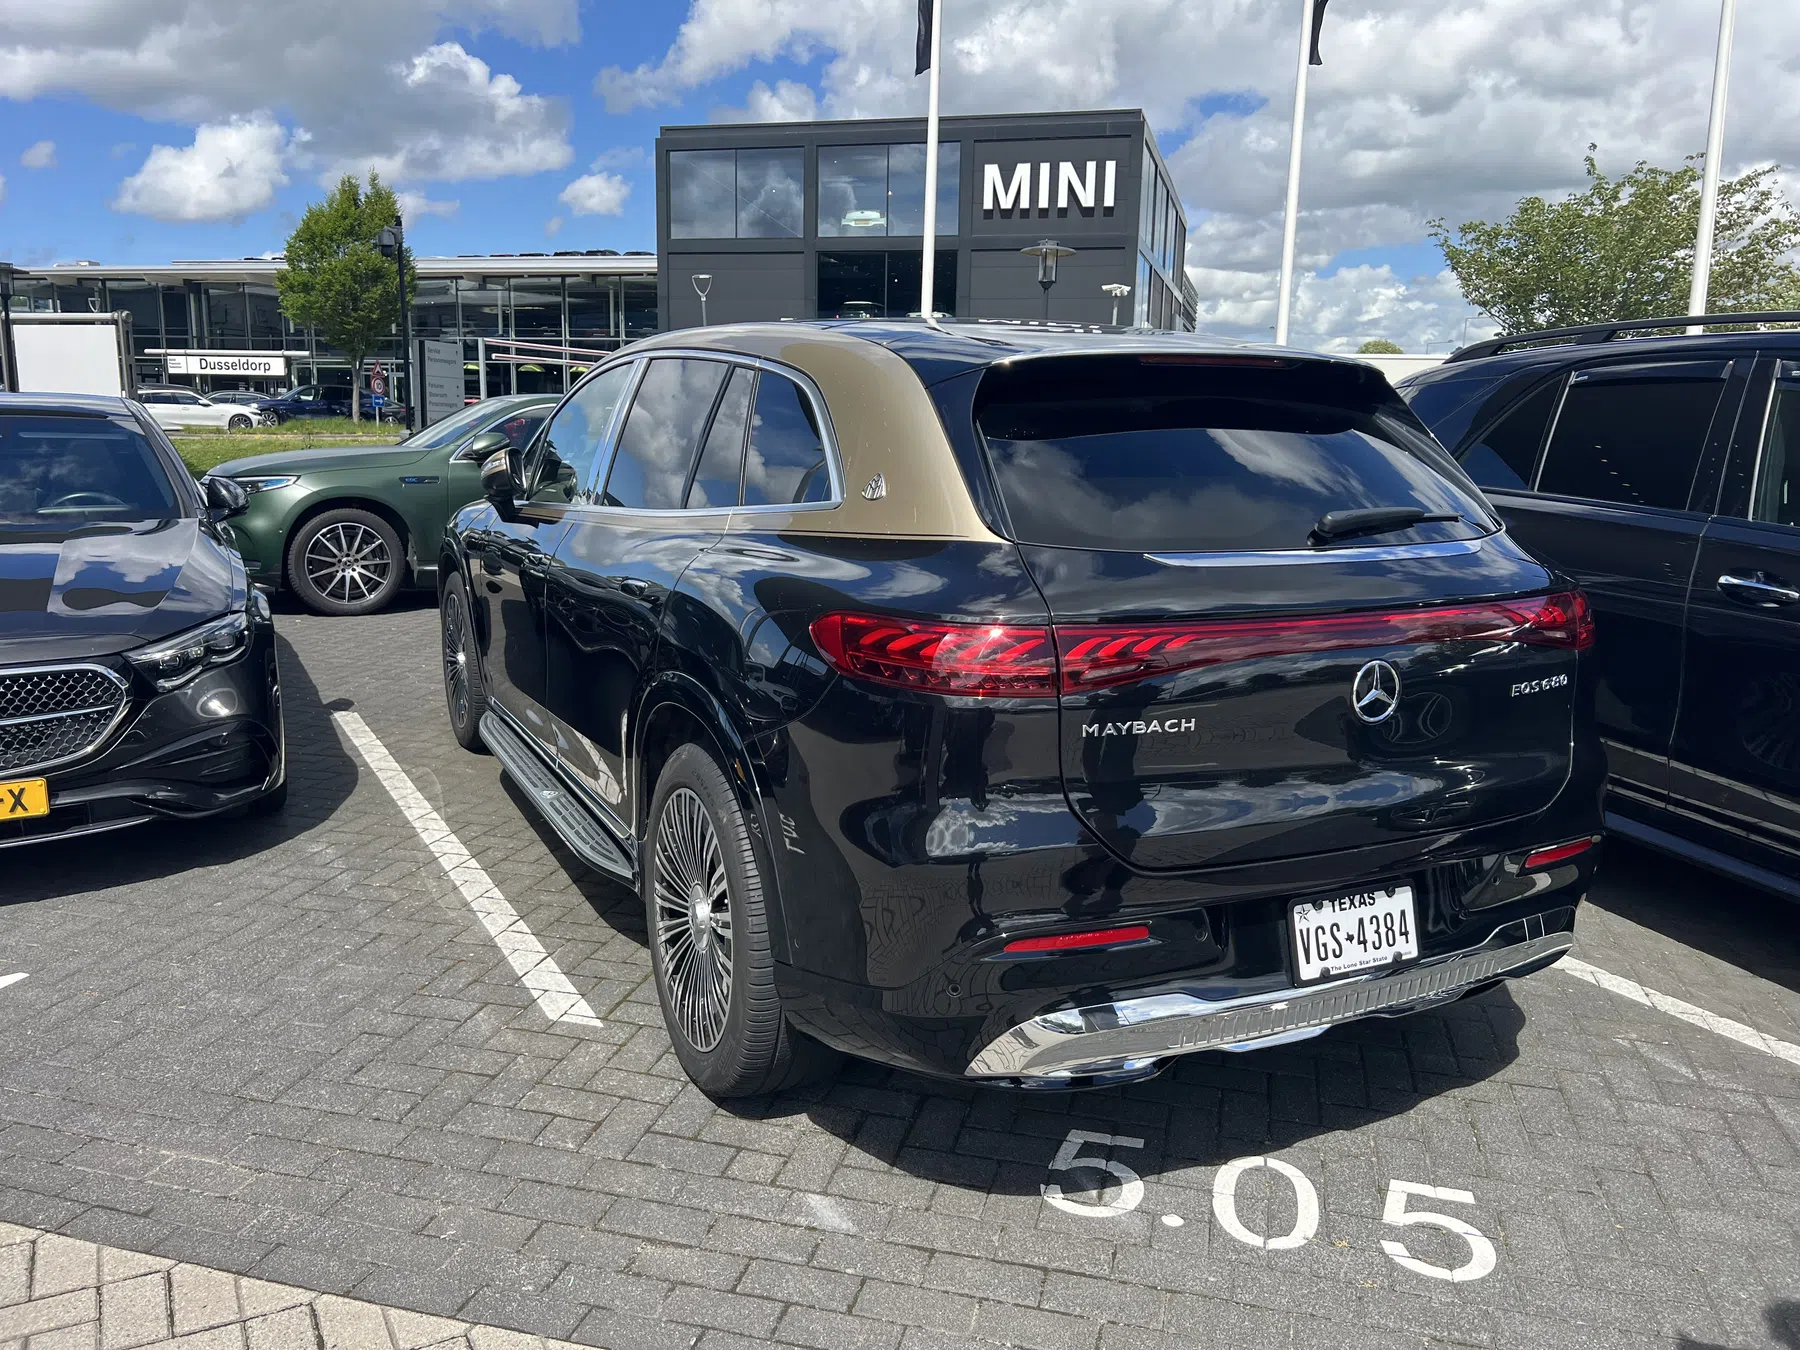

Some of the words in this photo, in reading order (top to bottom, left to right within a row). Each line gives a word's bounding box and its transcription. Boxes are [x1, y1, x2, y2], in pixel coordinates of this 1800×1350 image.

[983, 160, 1117, 210] MINI
[199, 358, 271, 374] Dusseldorp
[1082, 718, 1196, 738] MAYBACH
[1329, 892, 1376, 913] TEXAS
[1040, 1129, 1497, 1282] 5.05
